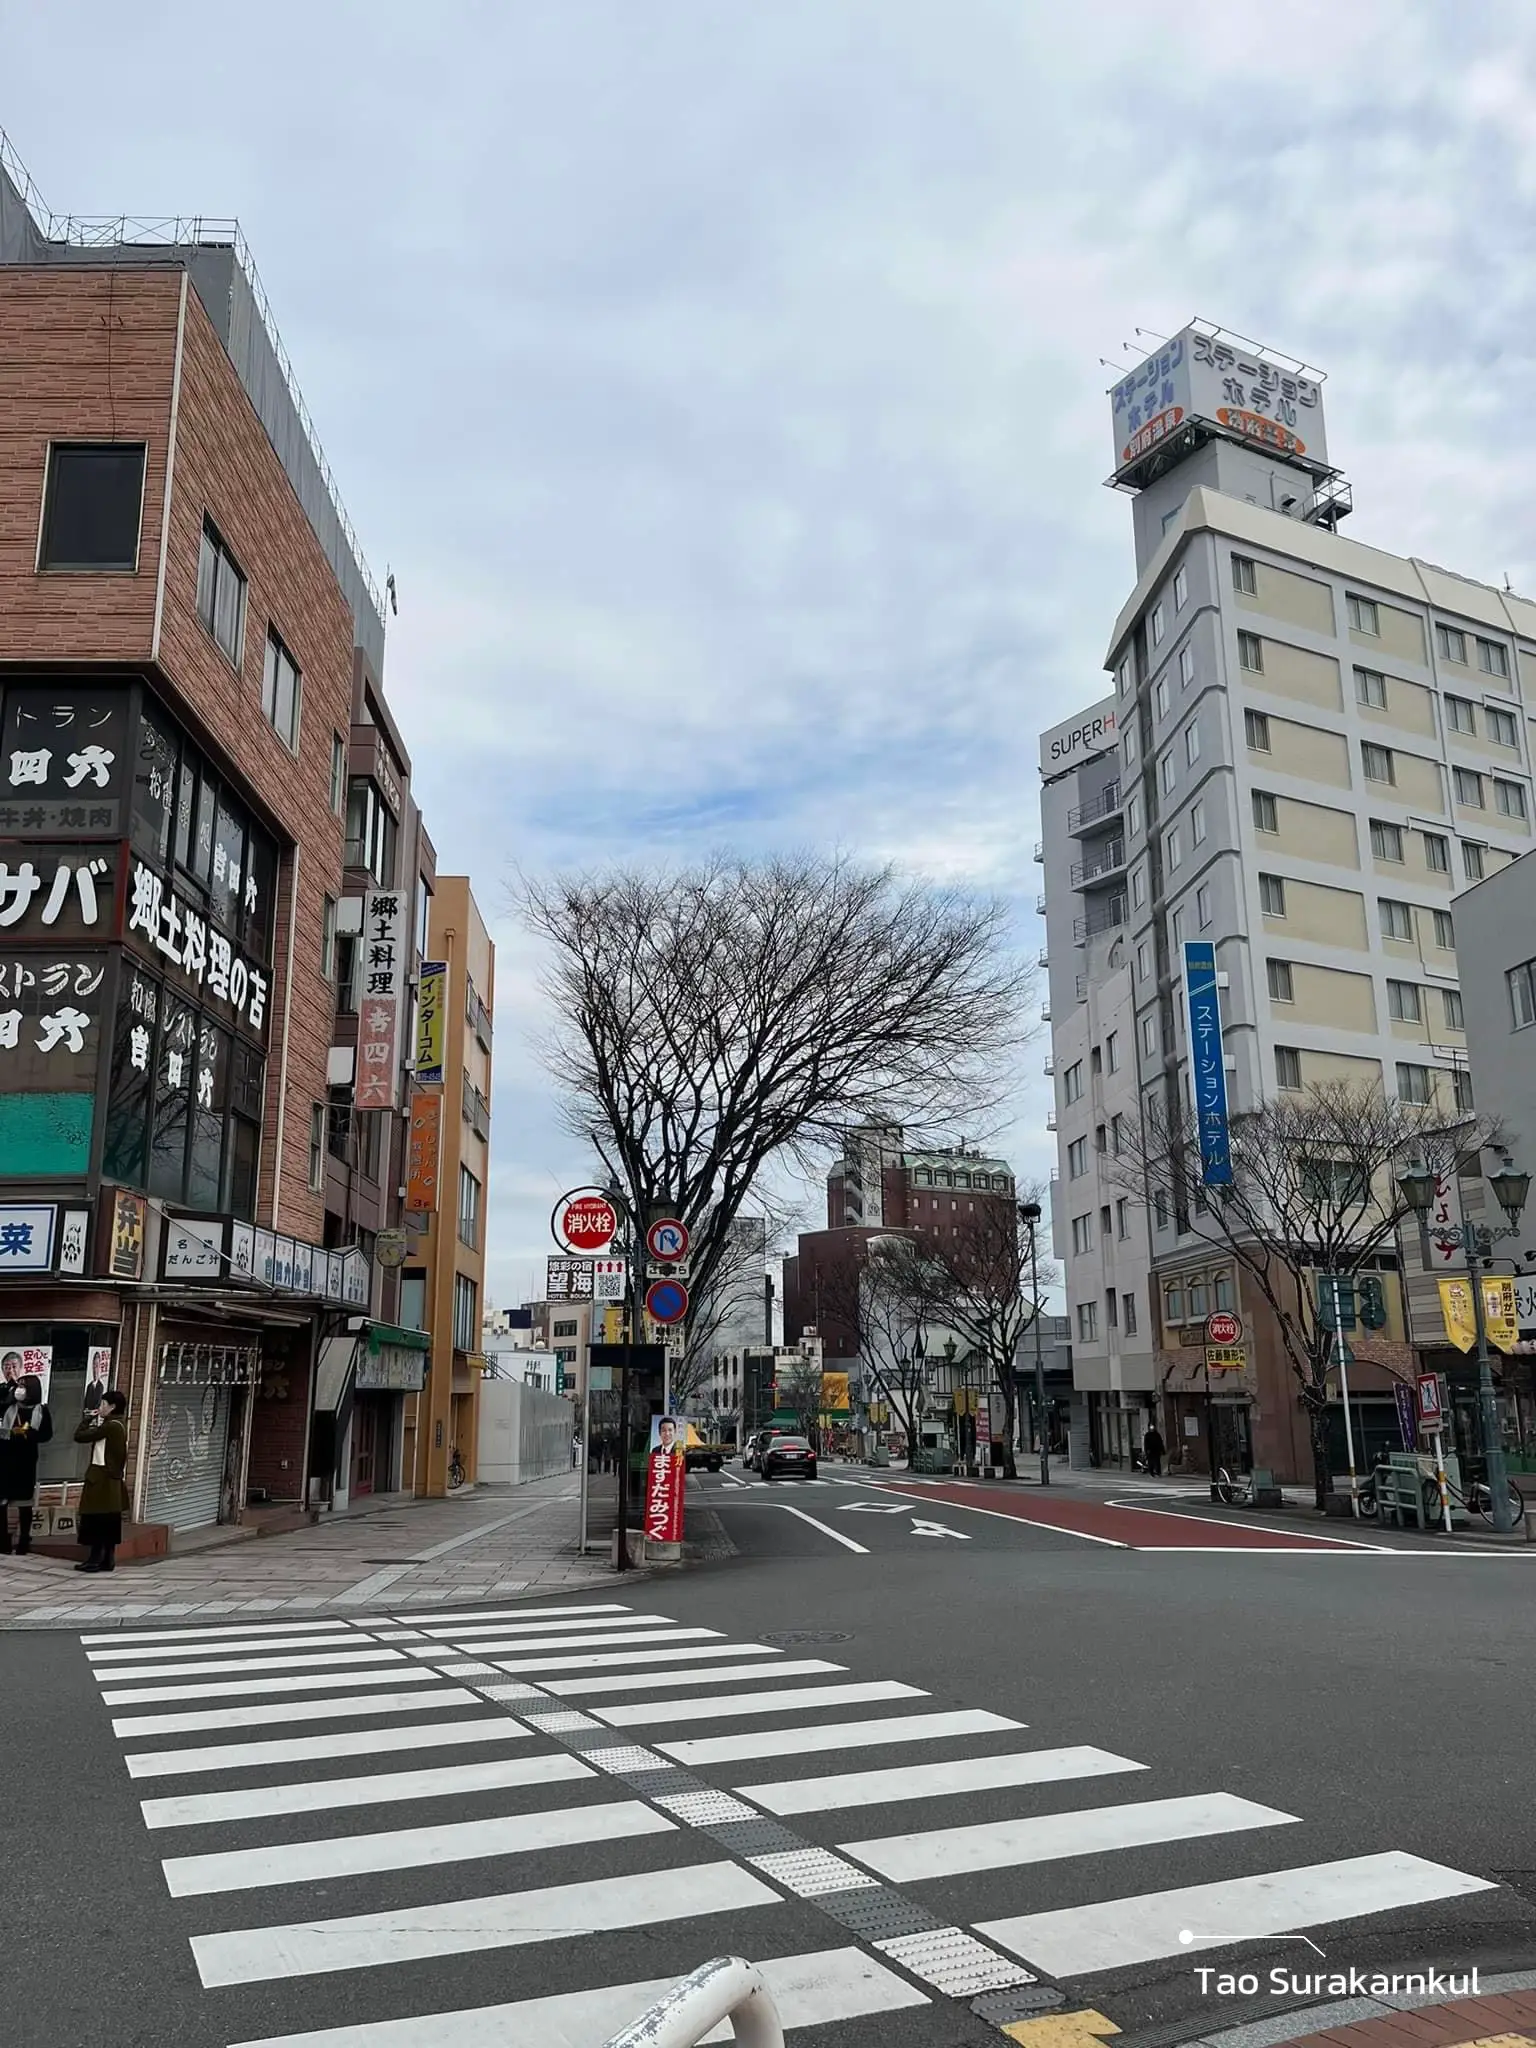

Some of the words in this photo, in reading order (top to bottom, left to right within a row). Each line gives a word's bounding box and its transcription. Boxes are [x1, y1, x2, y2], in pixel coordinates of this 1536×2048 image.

[1115, 340, 1183, 414] ステーション
[1128, 379, 1175, 433] ホテル
[1193, 336, 1318, 408] ステーション
[1222, 377, 1297, 428] ホテル
[367, 895, 398, 995] 郷土料理
[362, 1006, 392, 1101] 吉四六
[418, 978, 436, 1064] インターコム
[1197, 1005, 1224, 1166] ステーションホテル
[113, 1197, 140, 1276] 弁当
[167, 1254, 219, 1265] だんご汁
[567, 1212, 612, 1234] 消火栓
[548, 1271, 593, 1293] 望海
[24, 1361, 44, 1373] 安全
[649, 1455, 672, 1540] ますだみつぐ
